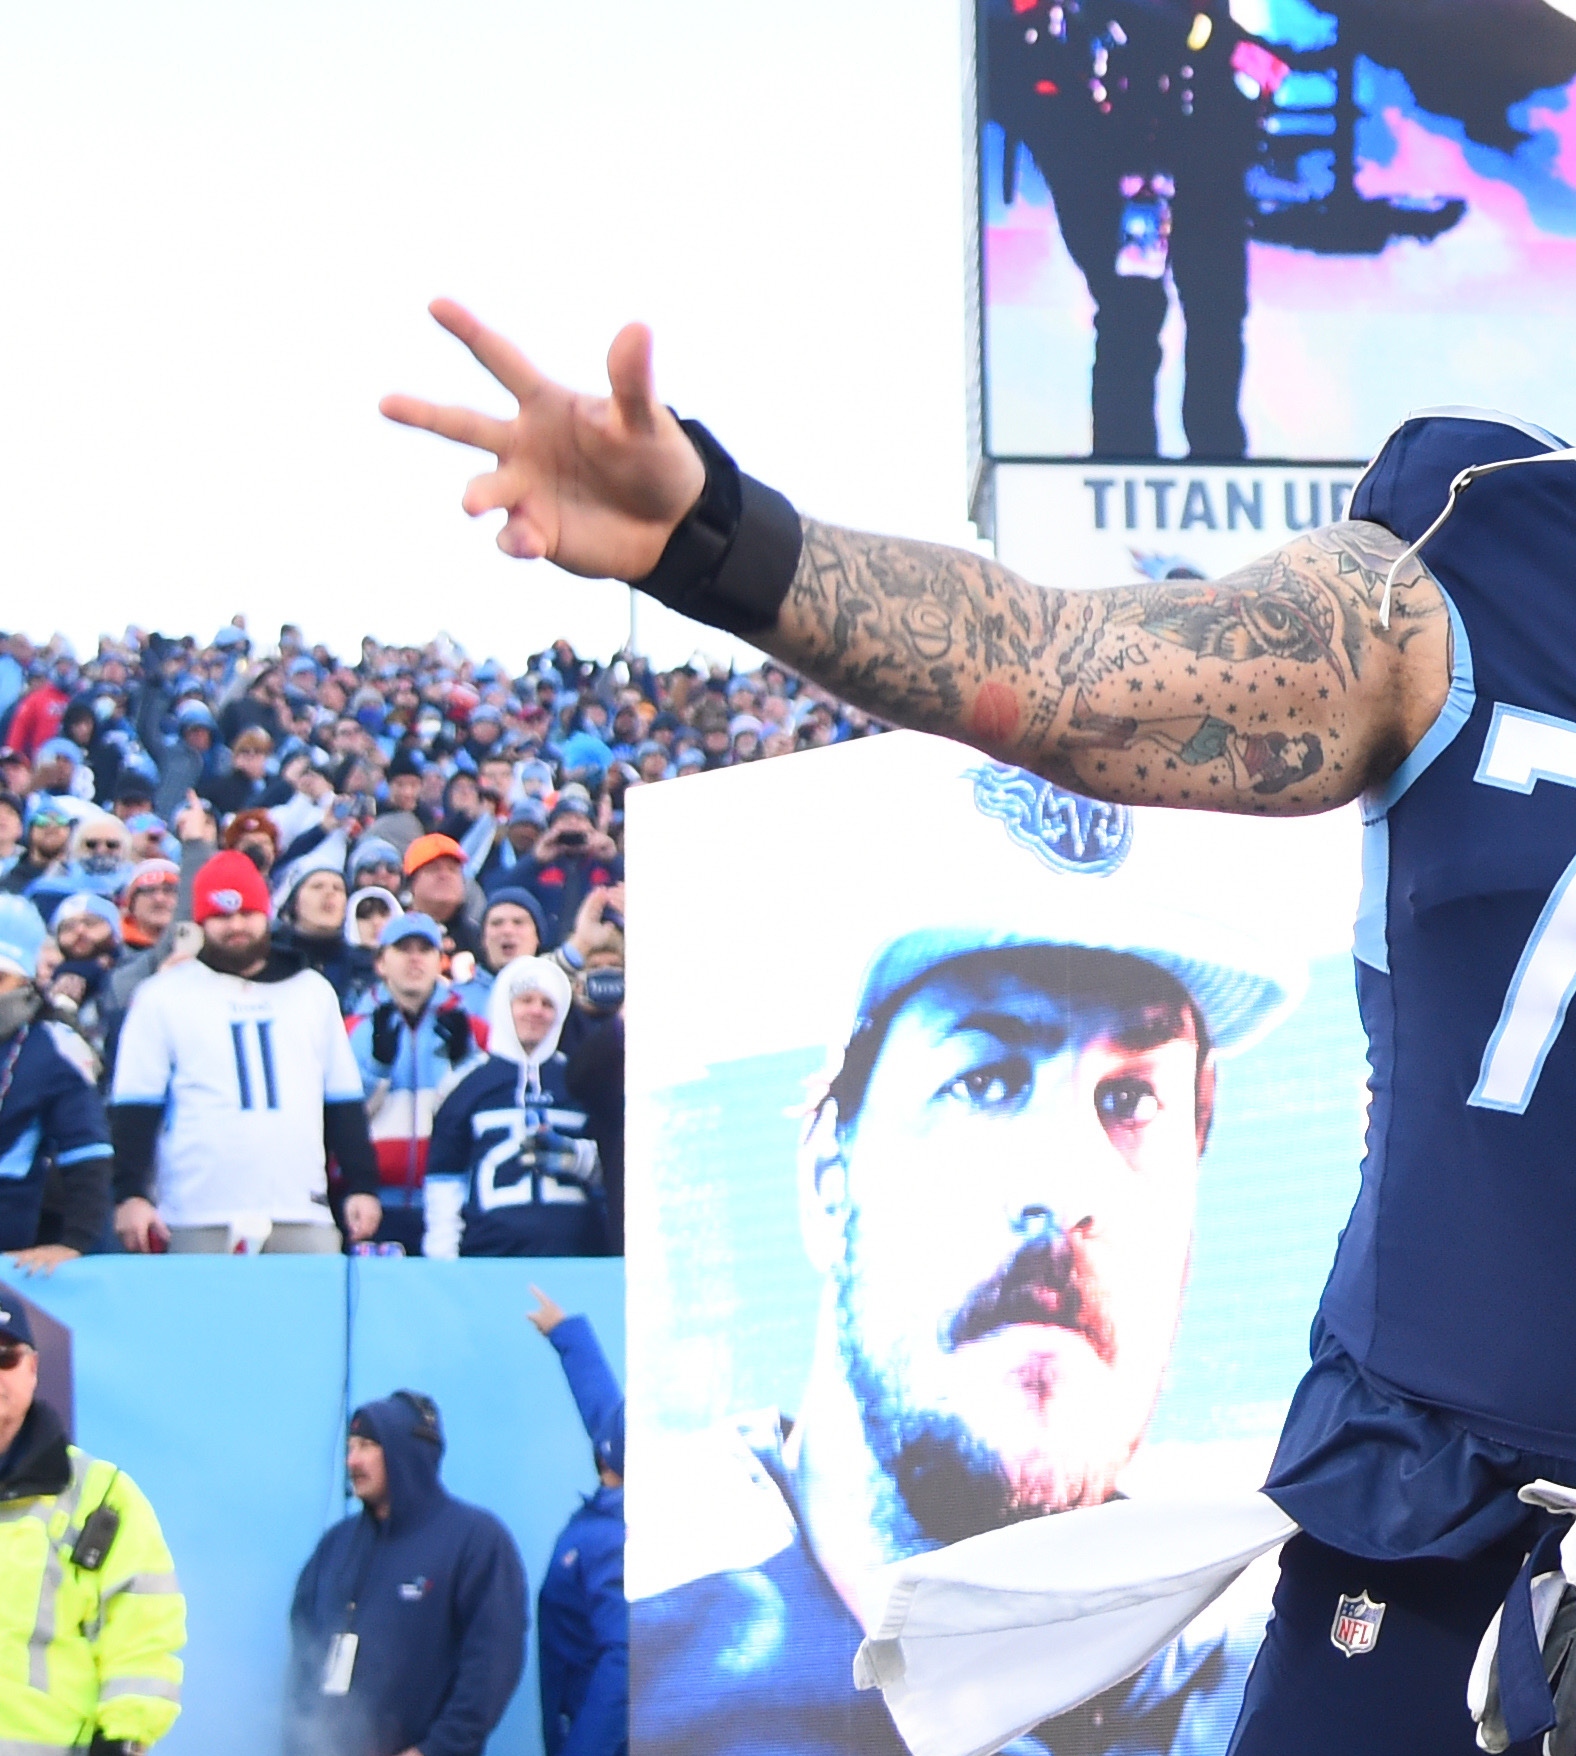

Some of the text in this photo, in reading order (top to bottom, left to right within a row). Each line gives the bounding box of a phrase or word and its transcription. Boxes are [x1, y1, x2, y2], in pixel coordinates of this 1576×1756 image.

[1082, 477, 1263, 531] TITAN
[228, 1019, 281, 1111] 11
[1337, 1617, 1370, 1646] NFL
